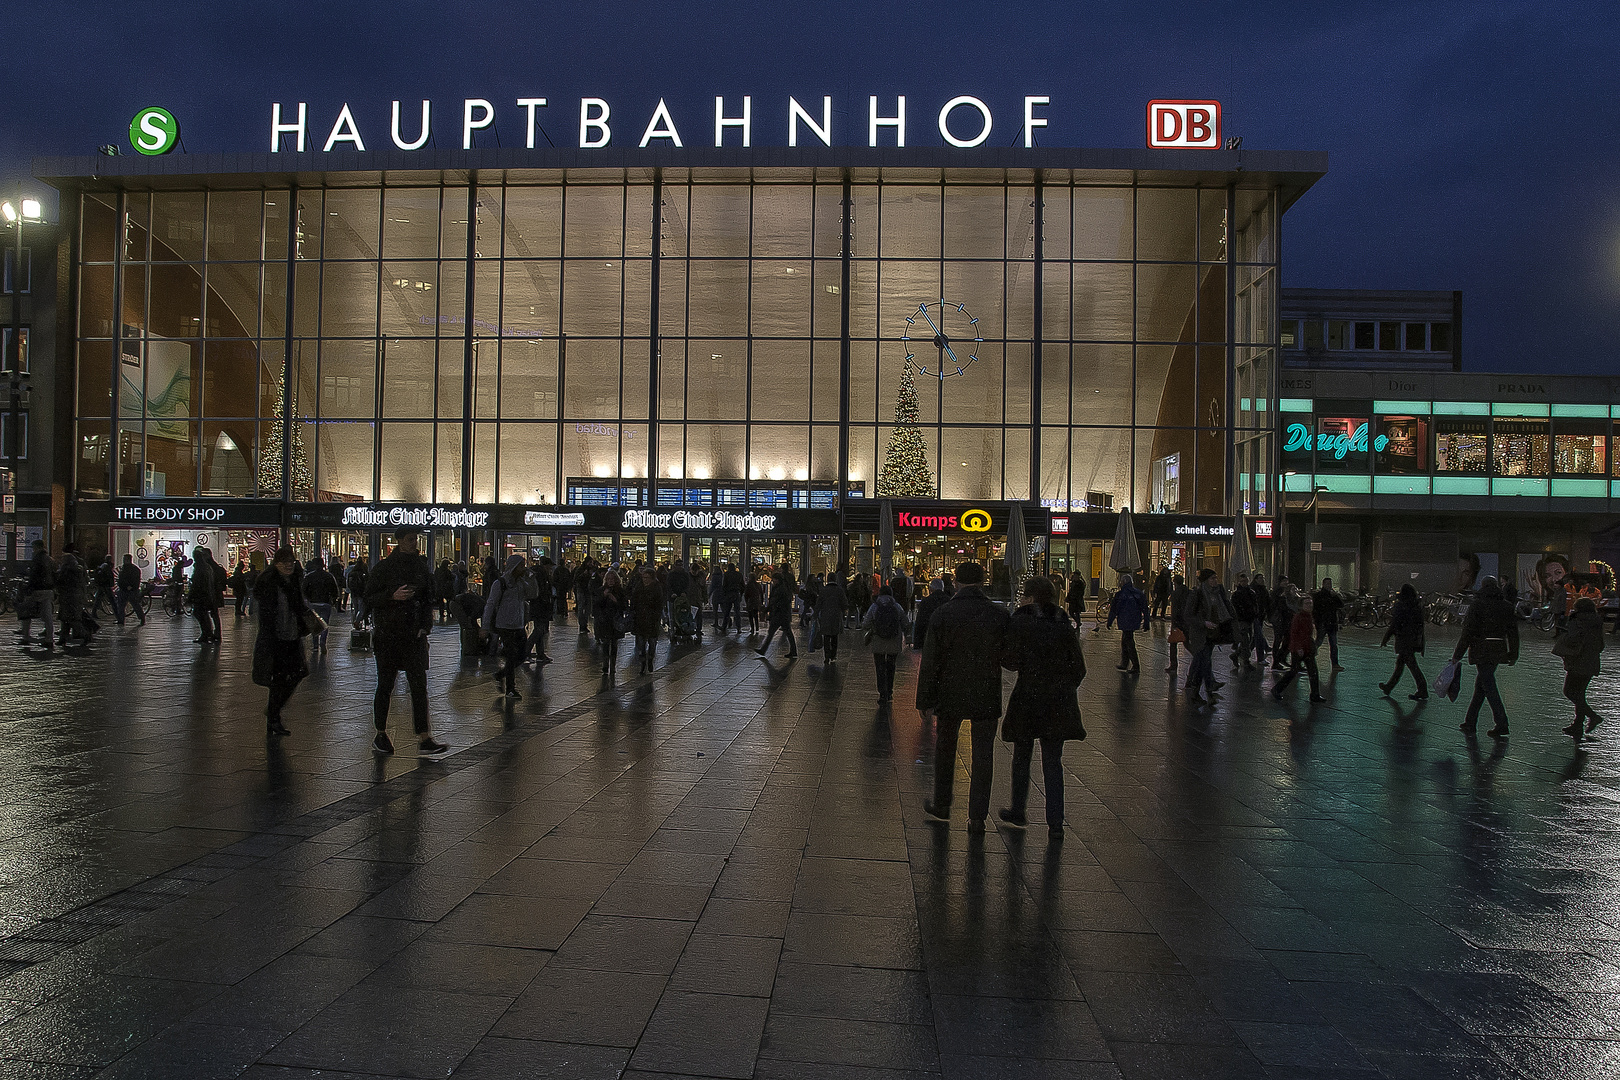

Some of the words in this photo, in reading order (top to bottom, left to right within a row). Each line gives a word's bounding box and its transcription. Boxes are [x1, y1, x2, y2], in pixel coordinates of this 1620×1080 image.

[138, 112, 168, 151] S
[271, 95, 1050, 153] HAUPTBAHNHOF
[1156, 108, 1212, 142] DB
[1389, 380, 1418, 392] Dior
[1497, 383, 1546, 395] PRADA
[1283, 422, 1390, 460] Douglas
[114, 507, 142, 520] THE
[147, 507, 186, 521] BODY
[187, 508, 225, 521] SHOP
[341, 507, 389, 526] Kölner
[622, 510, 672, 528] Kölner
[898, 512, 958, 531] Kamps
[1175, 524, 1208, 535] schnell.
[1209, 525, 1235, 536] schne
[157, 557, 179, 568] PLAY
